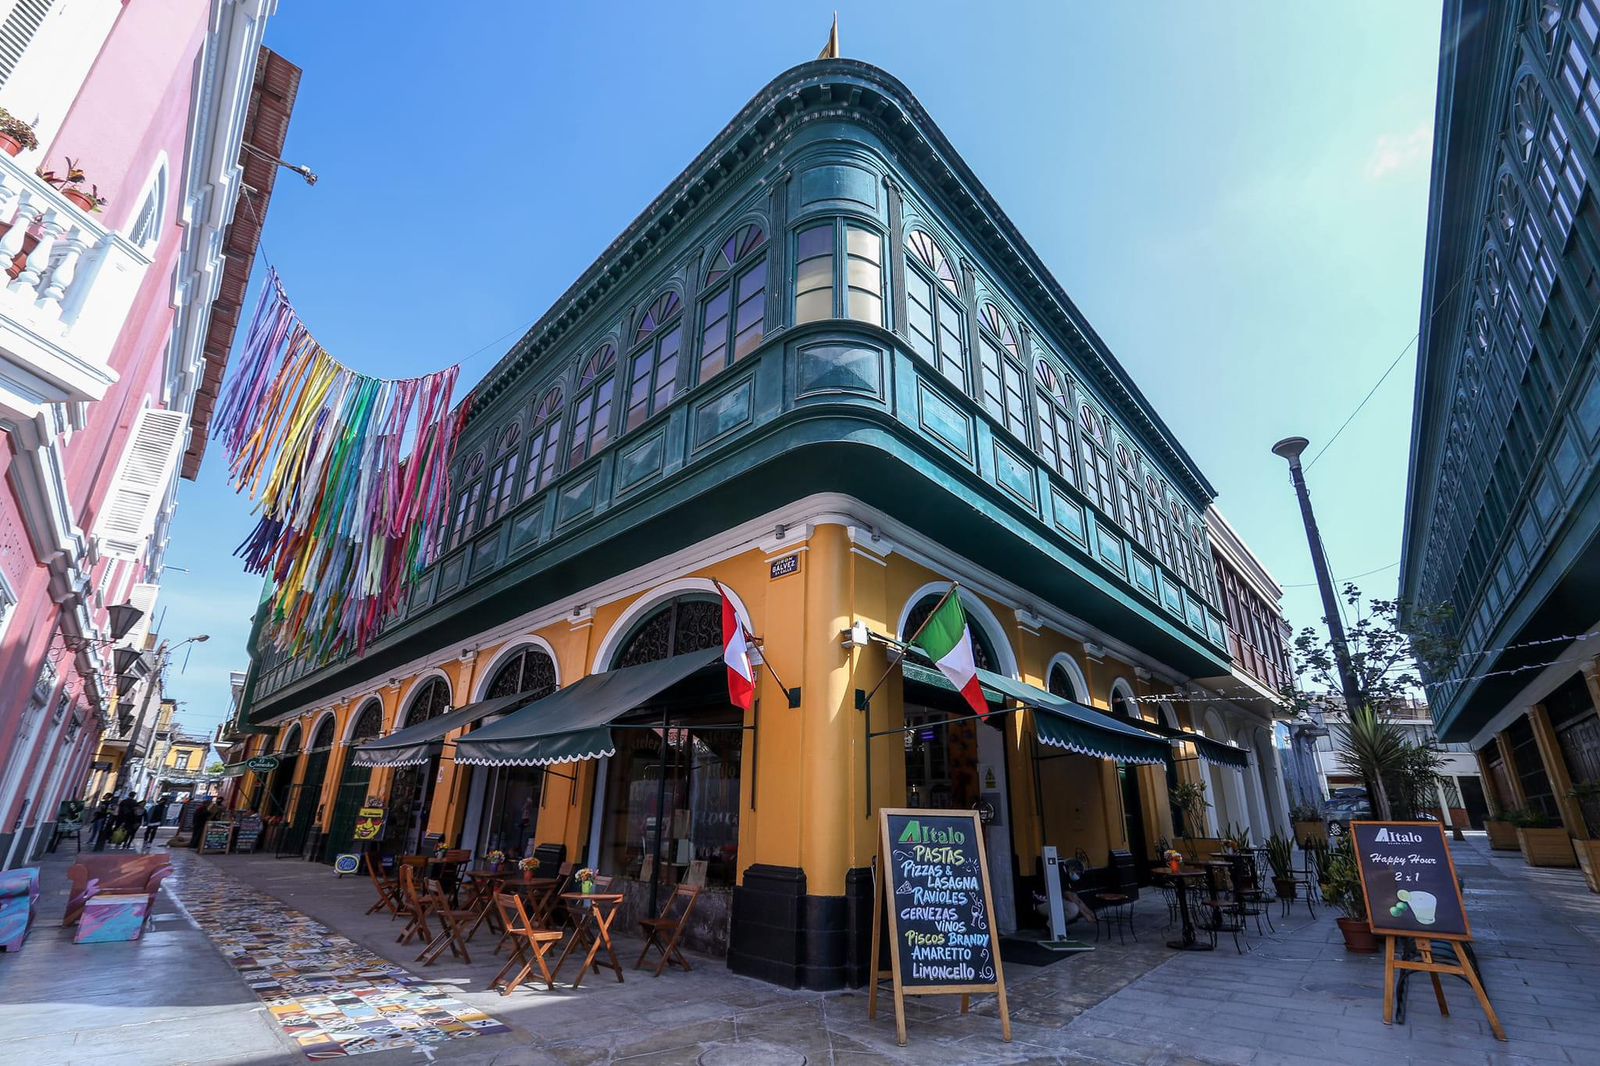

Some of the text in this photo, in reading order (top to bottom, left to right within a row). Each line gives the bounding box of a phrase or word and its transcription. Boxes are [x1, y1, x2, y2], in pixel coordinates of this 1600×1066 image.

[772, 560, 795, 572] GALVEZ
[913, 845, 966, 866] PASTAS
[1370, 853, 1437, 866] Happy Hour
[945, 865, 952, 875] &
[1394, 872, 1402, 881] 2
[1415, 872, 1420, 881] 1
[927, 875, 979, 890] LASAGNA
[900, 907, 959, 921] CERVEZAS
[948, 933, 990, 948] BRANDY
[910, 947, 972, 961] AMARETTO
